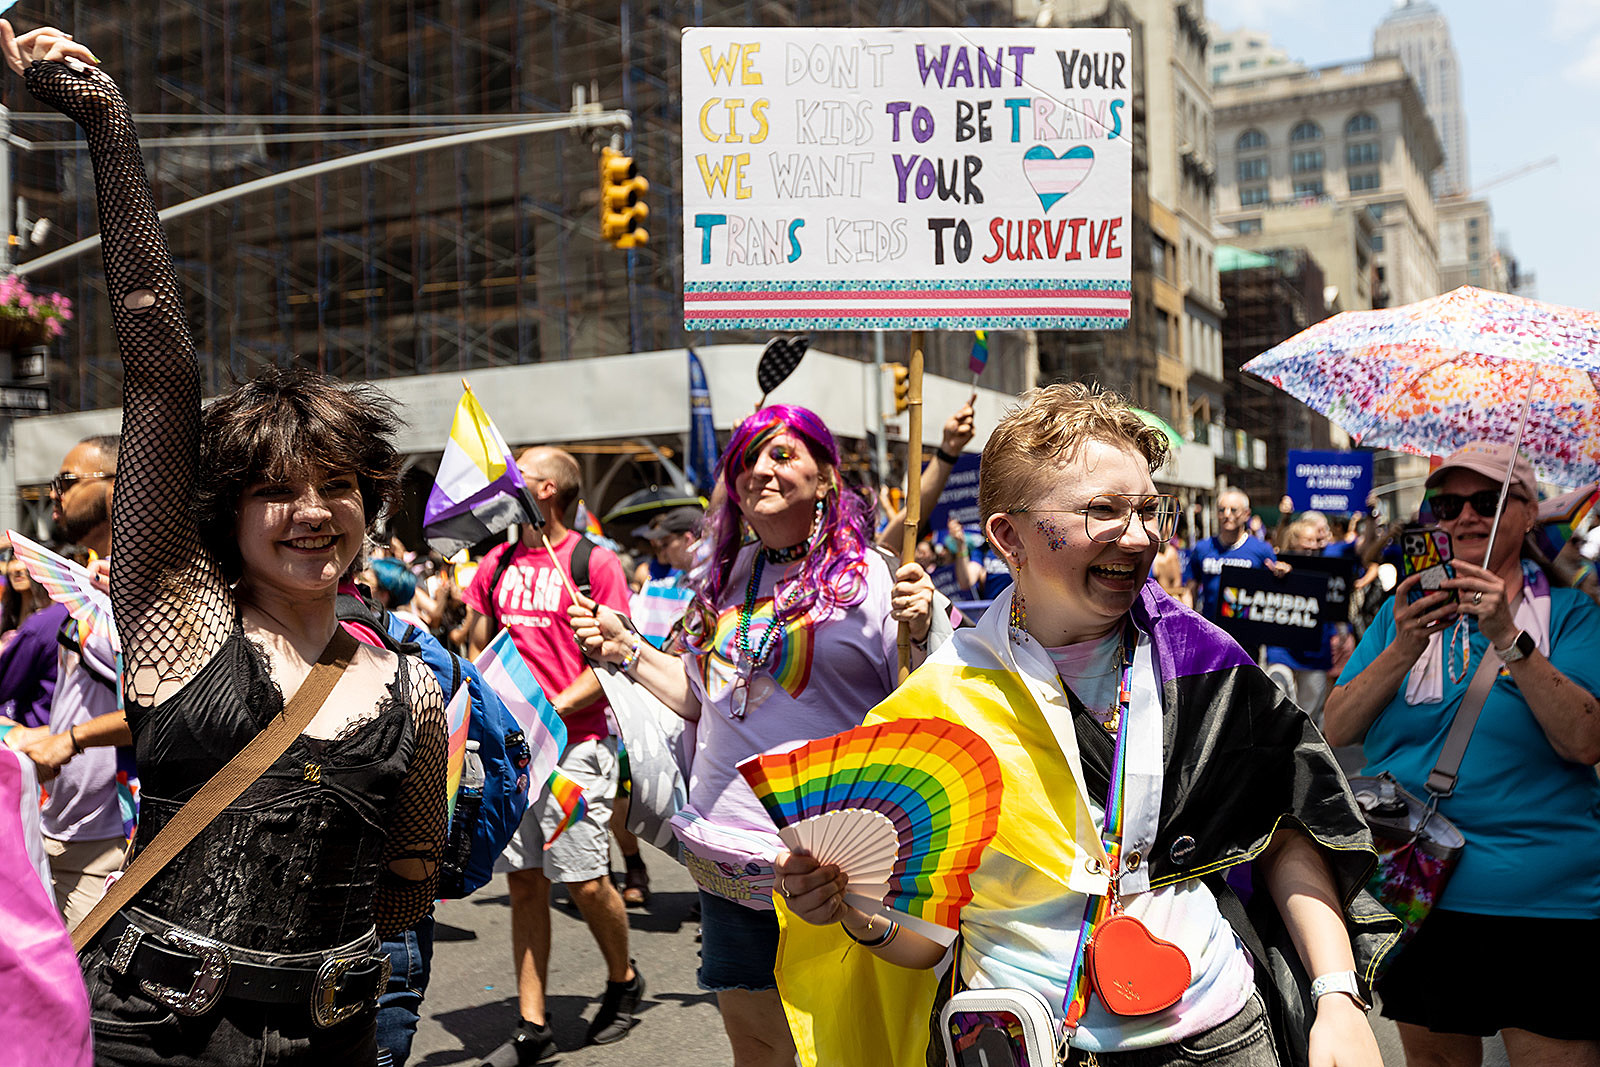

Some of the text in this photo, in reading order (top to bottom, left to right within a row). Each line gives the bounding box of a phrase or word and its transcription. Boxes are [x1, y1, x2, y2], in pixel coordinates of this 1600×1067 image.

[699, 39, 1126, 90] WE DON'T WANT YOUR
[699, 97, 1125, 146] CIS KIDS TO BE TRANS
[695, 150, 985, 204] WE WANT YOUR
[694, 213, 1123, 266] TRANS KIDS TO SURVIVE
[1340, 465, 1363, 479] NOT
[1238, 587, 1320, 615] LAMBDA
[1249, 605, 1318, 628] LEGAL
